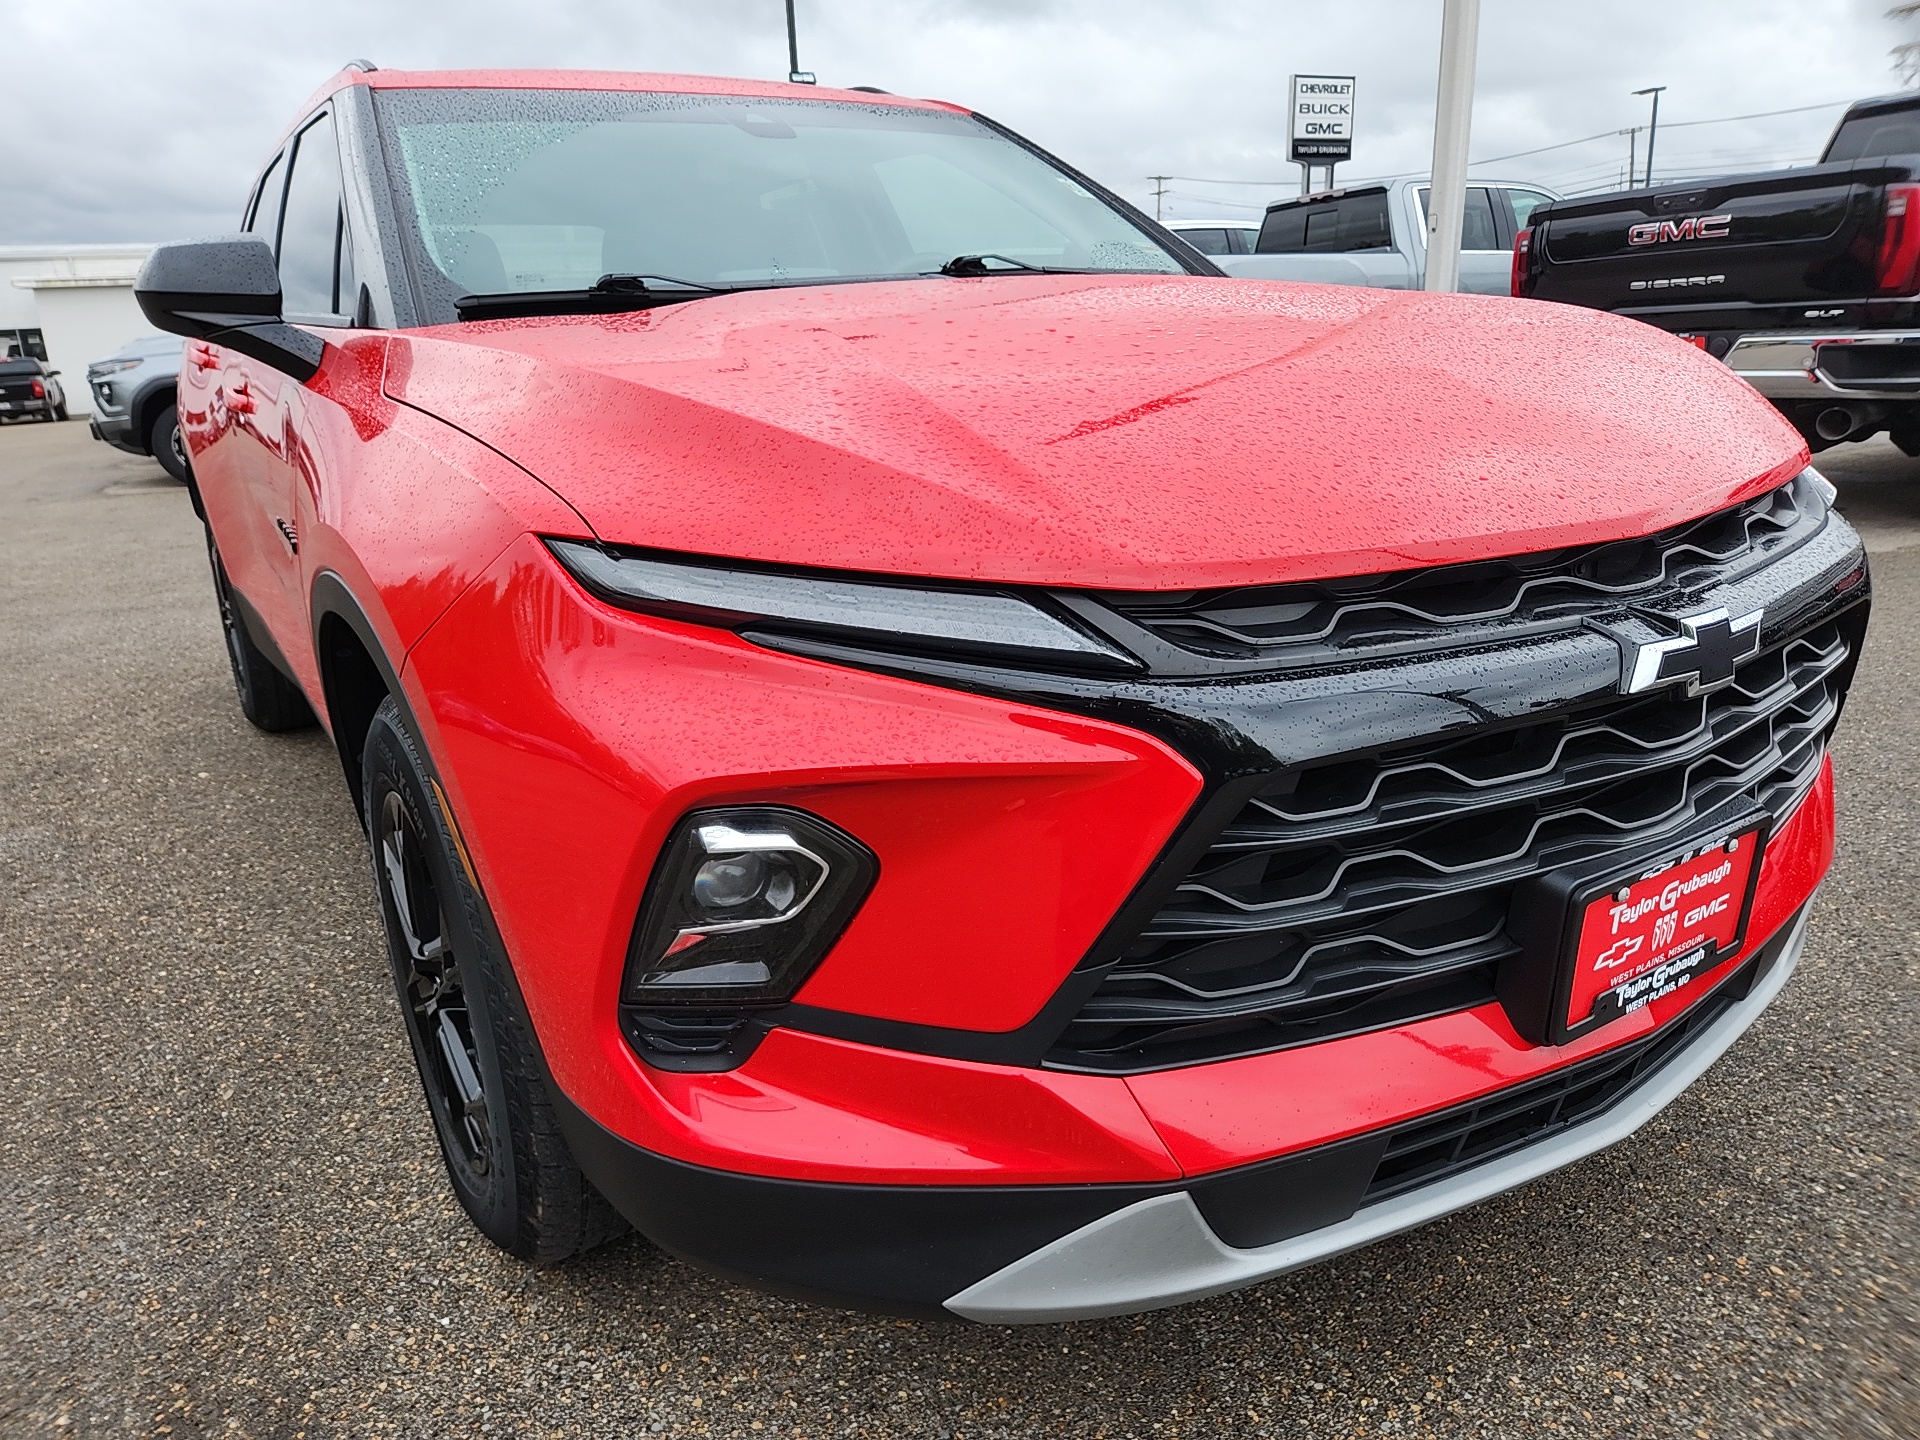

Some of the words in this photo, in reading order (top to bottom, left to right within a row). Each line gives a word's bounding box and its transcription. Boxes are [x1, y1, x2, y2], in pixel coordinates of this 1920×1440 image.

[1300, 83, 1351, 94] CHEVROLET
[1299, 103, 1350, 115] BUICK
[1305, 123, 1343, 134] GMC
[1628, 213, 1732, 246] GMC
[1630, 274, 1726, 290] SIERRA
[1700, 835, 1729, 855] GMC
[1684, 893, 1731, 929] GMC
[1610, 968, 1635, 987] WEST
[1636, 953, 1666, 975] PLAINS,
[1667, 933, 1705, 959] MISSOURI
[1625, 998, 1649, 1014] WEST
[1649, 980, 1677, 1003] PLAINS,
[1677, 973, 1691, 987] MO
